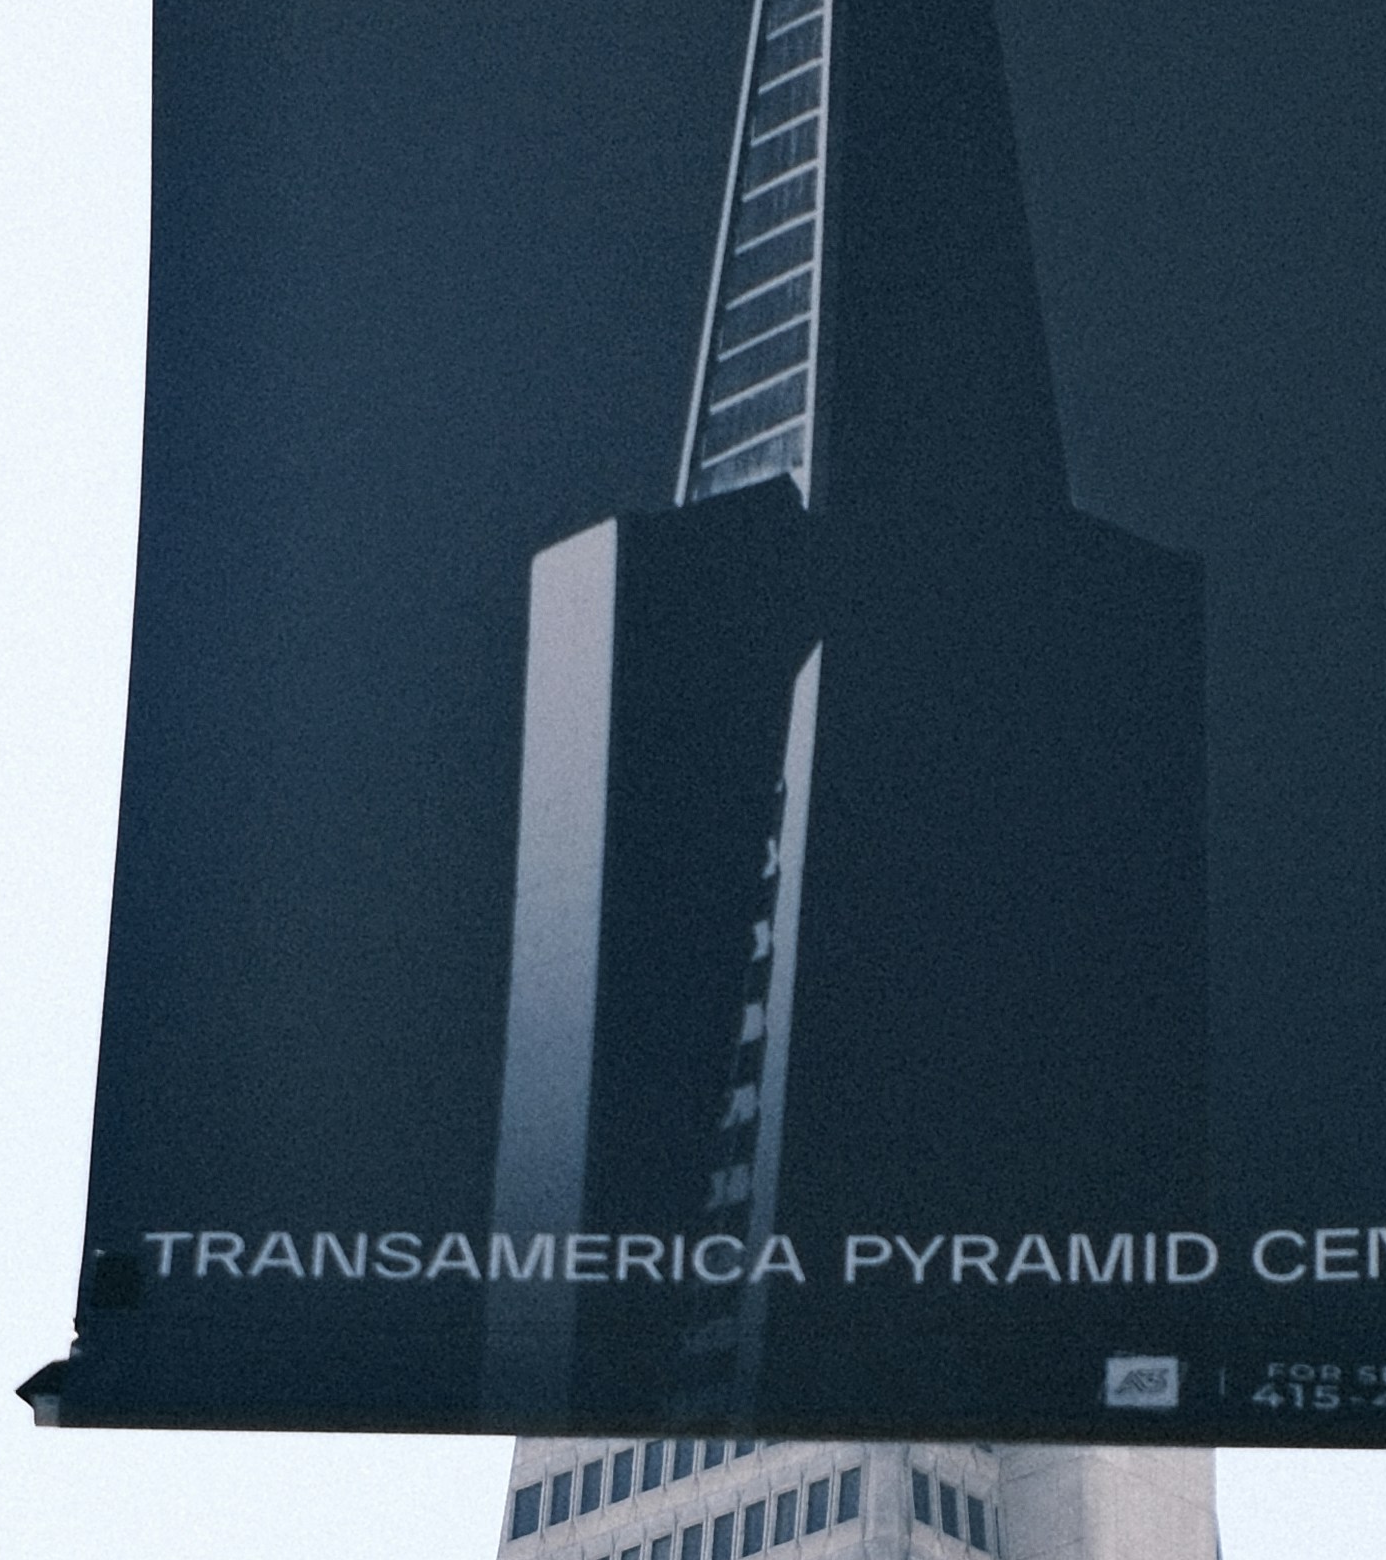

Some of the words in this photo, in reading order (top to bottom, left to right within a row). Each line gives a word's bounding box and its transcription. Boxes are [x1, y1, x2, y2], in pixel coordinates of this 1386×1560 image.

[144, 1230, 806, 1284] TRANSAMERICA
[843, 1232, 1220, 1284] PYRAMID
[1267, 1362, 1342, 1382] FOR
